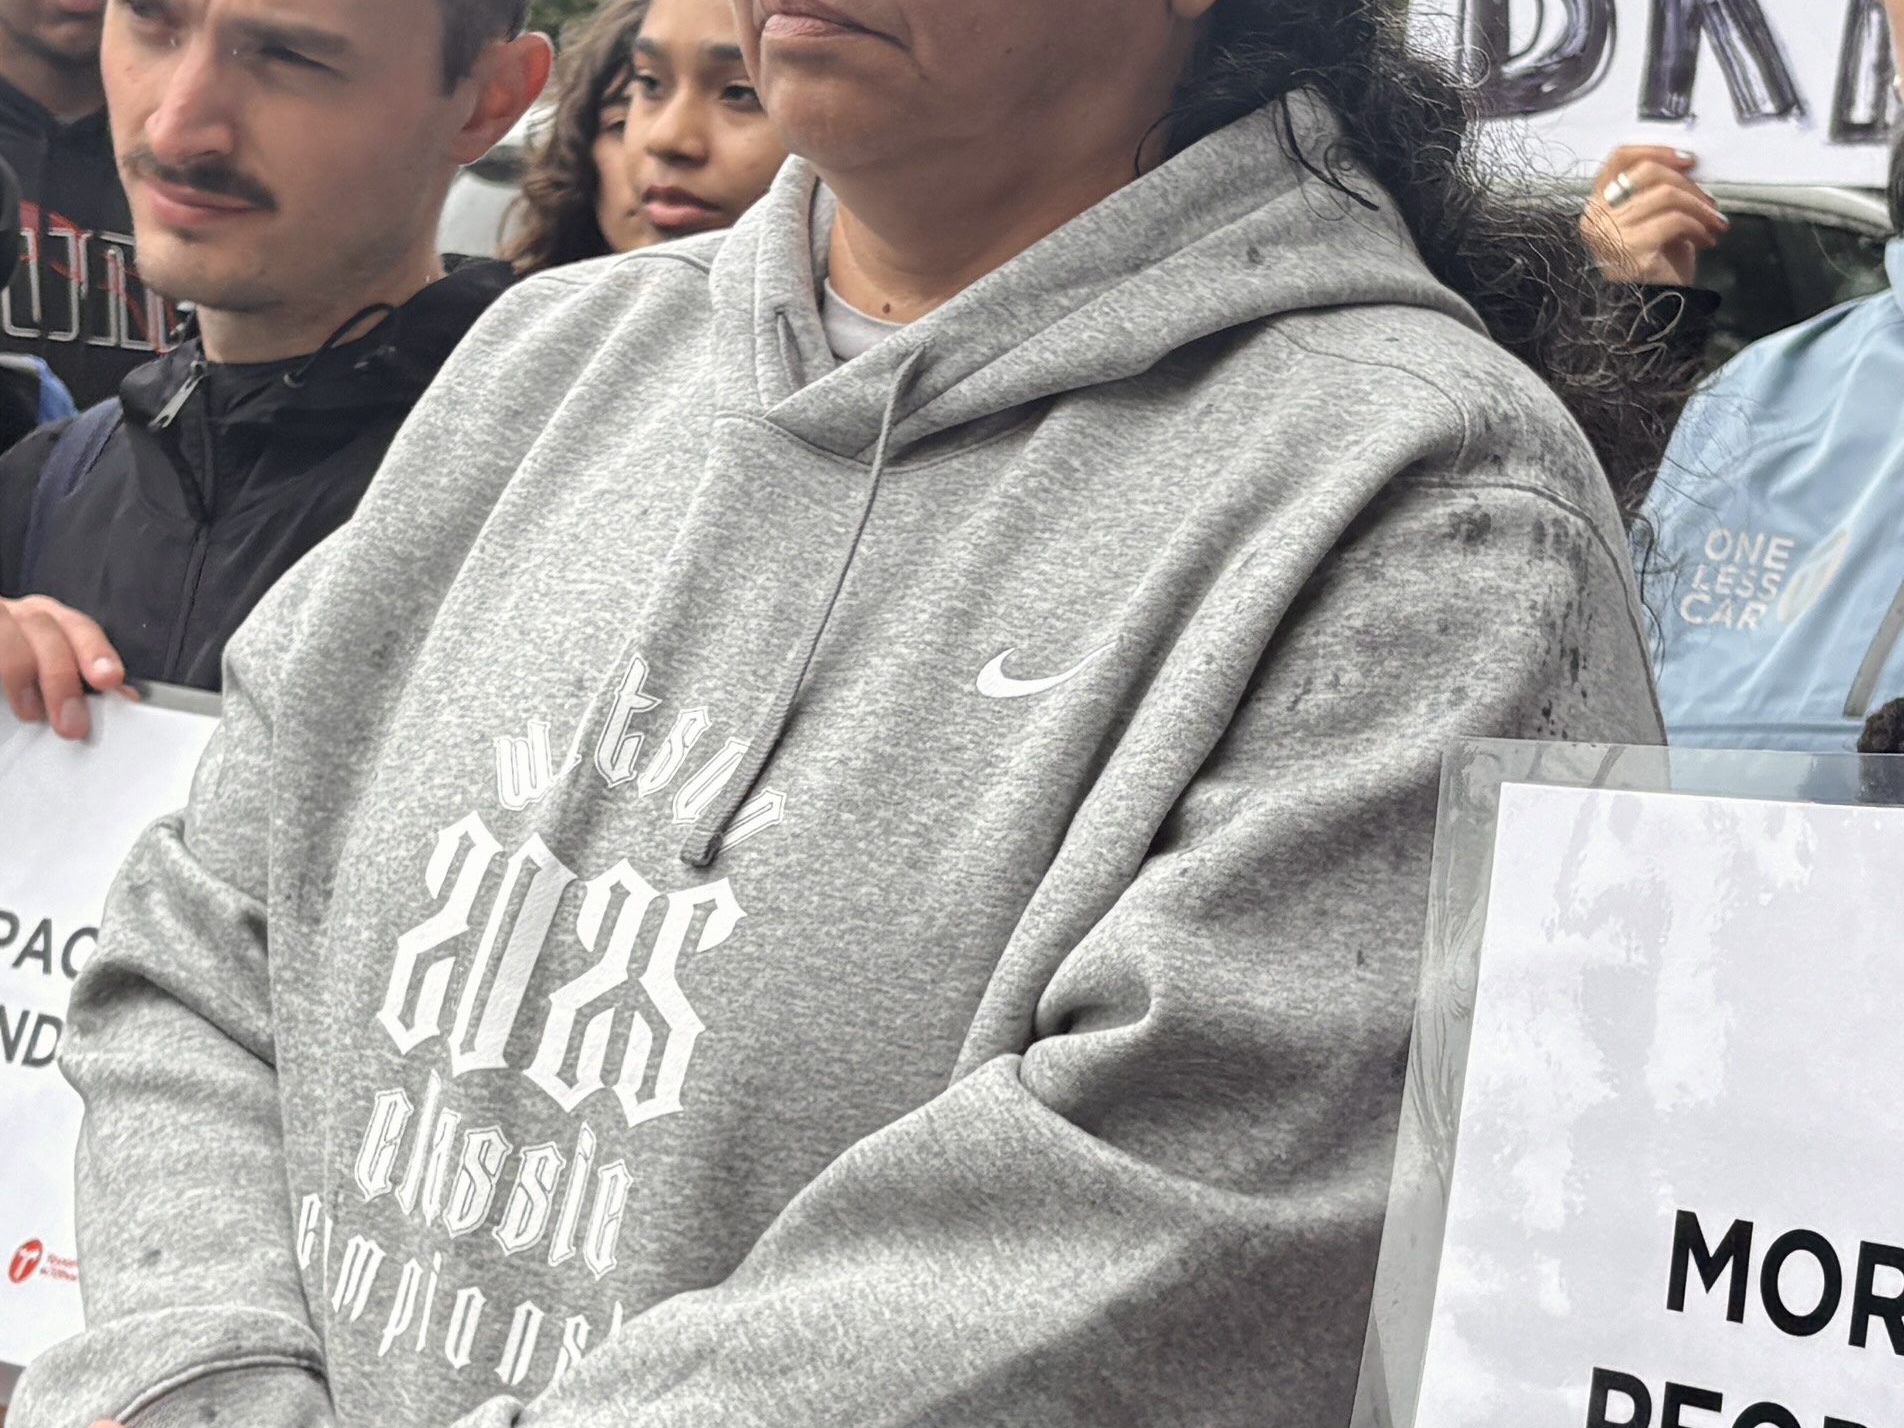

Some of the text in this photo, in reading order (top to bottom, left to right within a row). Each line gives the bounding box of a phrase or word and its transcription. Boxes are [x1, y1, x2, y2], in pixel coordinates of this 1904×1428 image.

[1704, 528, 1796, 572] ONE
[1690, 563, 1782, 602] LESS
[1679, 591, 1768, 631] CAR
